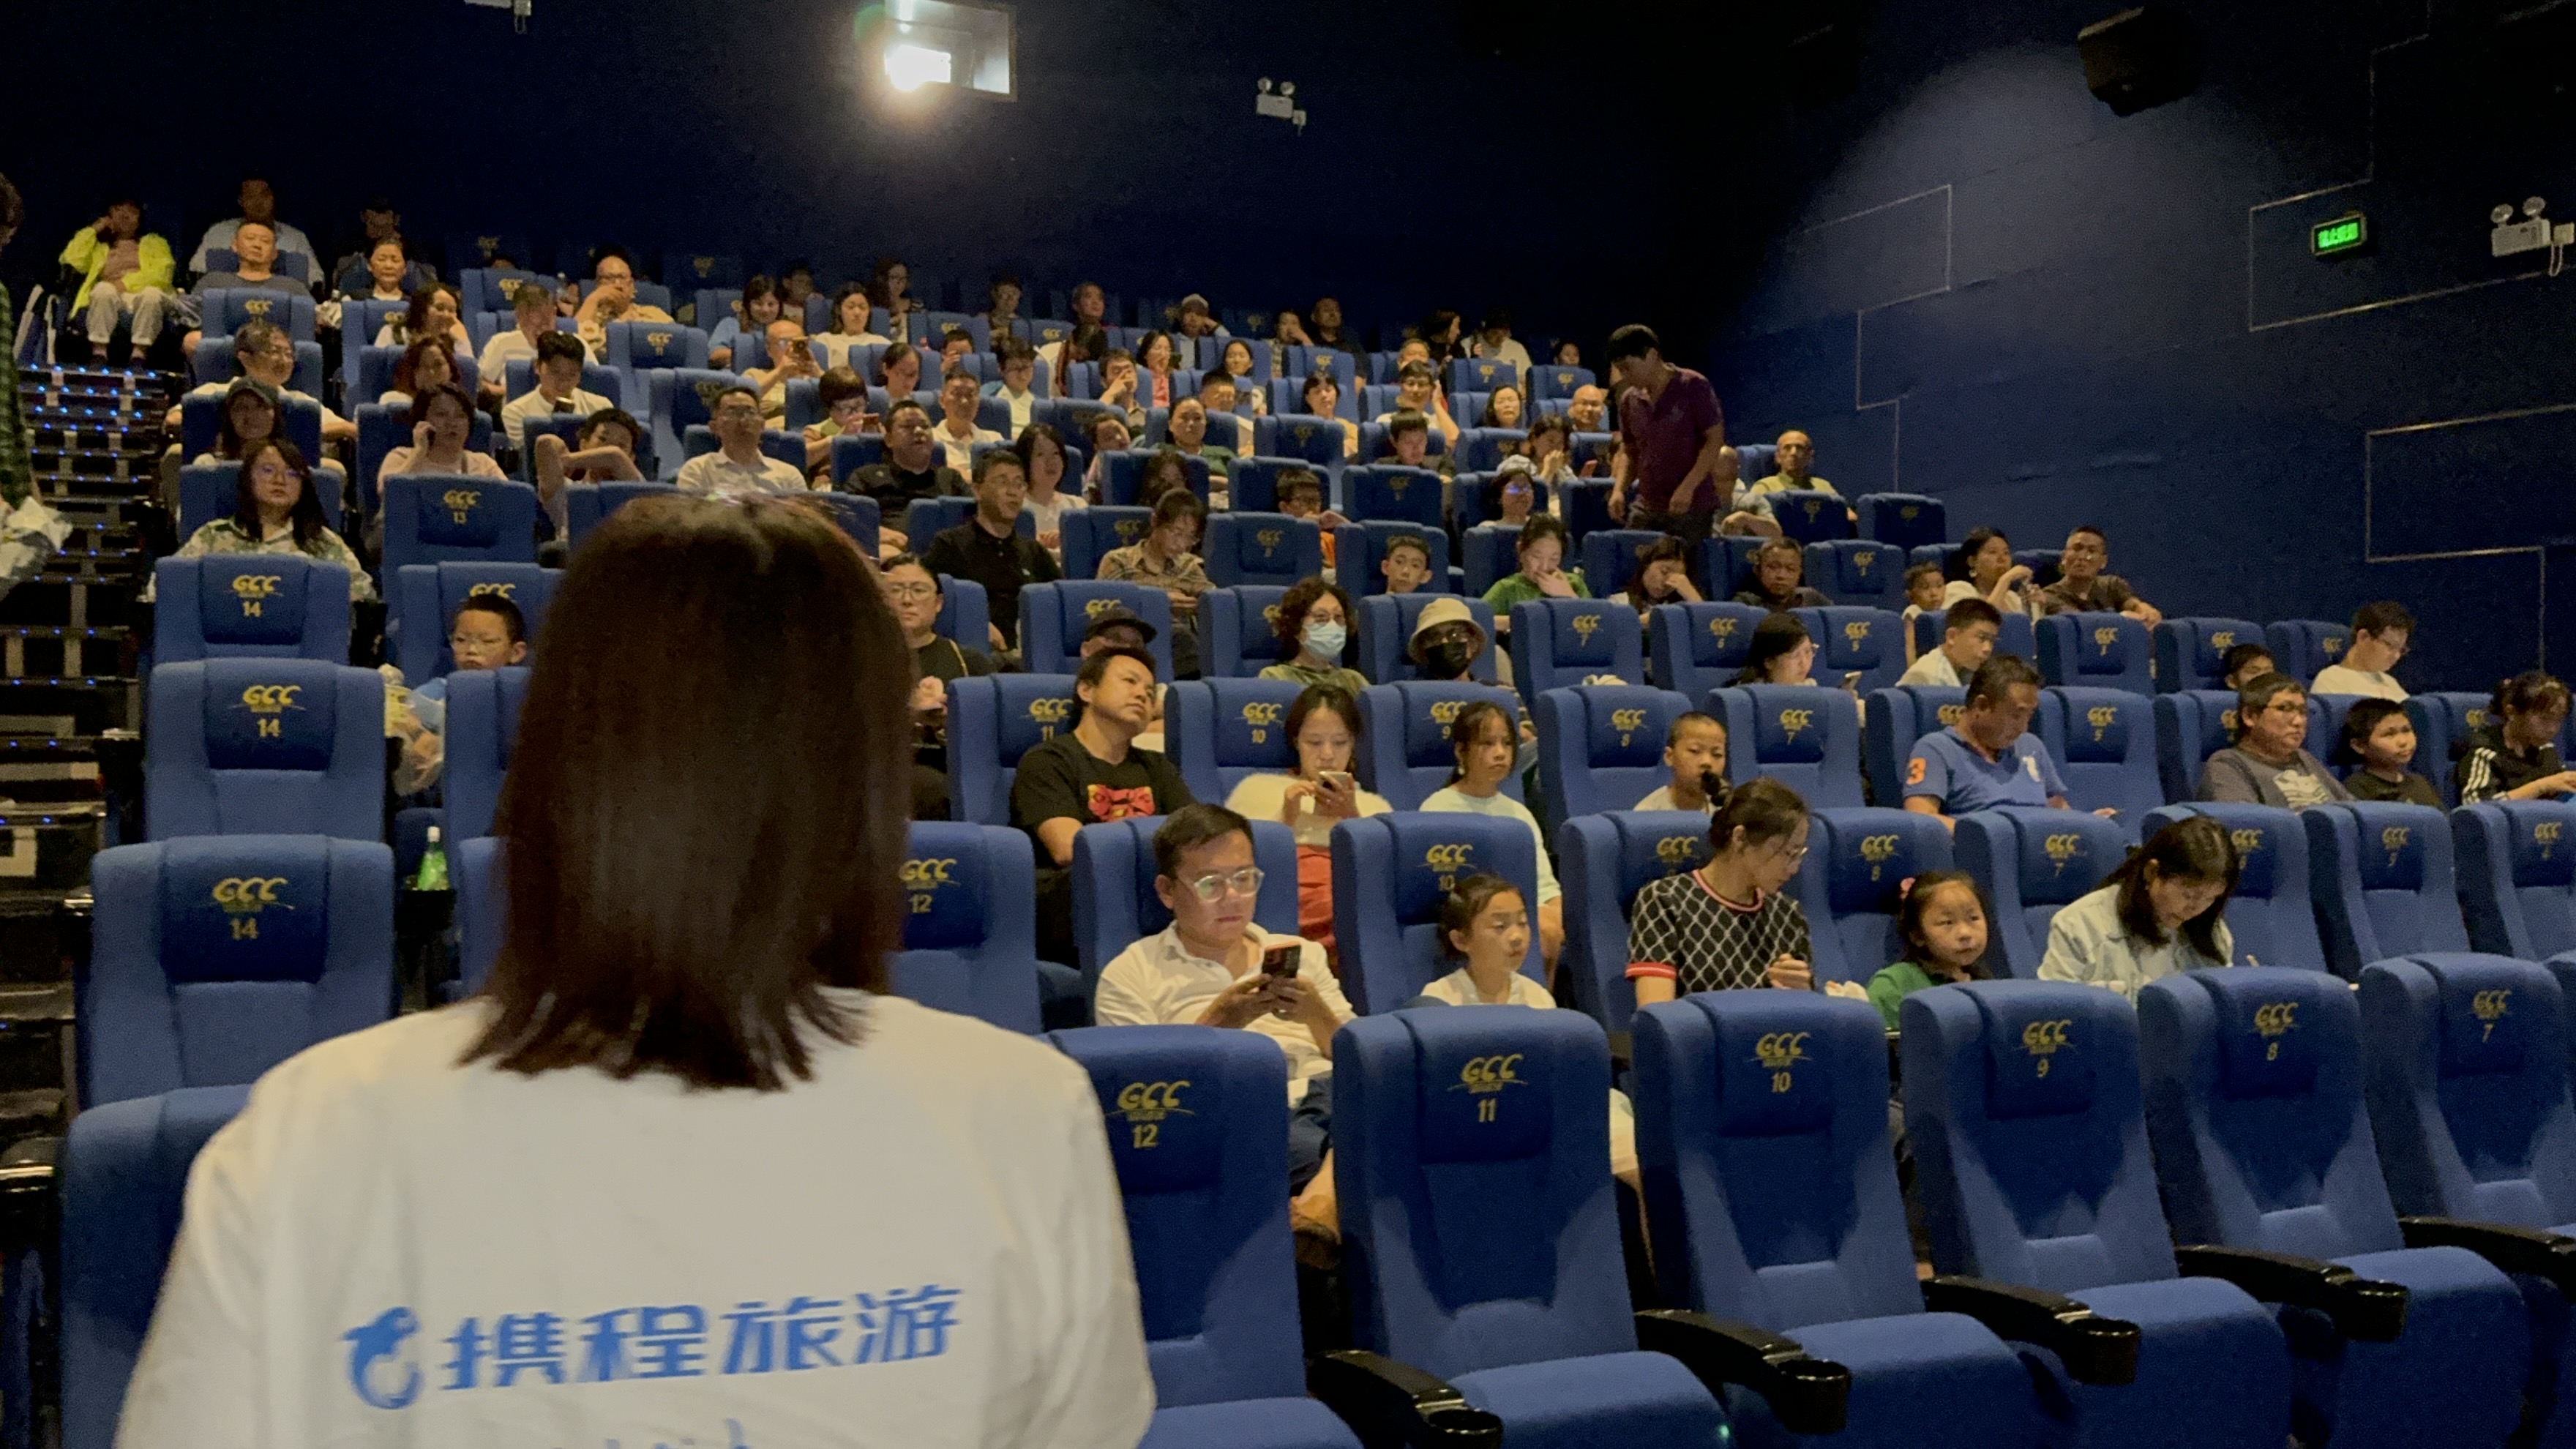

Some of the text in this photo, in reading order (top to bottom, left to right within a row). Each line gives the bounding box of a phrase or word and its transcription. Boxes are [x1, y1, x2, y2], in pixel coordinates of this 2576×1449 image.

[233, 574, 281, 592] GCC
[244, 601, 261, 618] 14
[1572, 615, 1600, 632] GCC
[243, 685, 302, 705] GCC
[1030, 699, 1073, 717] GCC
[1243, 703, 1281, 719] GCC
[1611, 709, 1646, 726] GCC
[1781, 709, 1813, 726] GCC
[2087, 707, 2117, 724] GCC
[256, 719, 280, 738] 14
[1251, 730, 1266, 744] 10
[1906, 757, 1926, 786] 3
[1656, 836, 1699, 856] GCC
[1861, 835, 1900, 854] GCC
[2045, 834, 2080, 853] GCC
[1426, 845, 1473, 864] GCC
[899, 858, 956, 882] GCC
[213, 877, 288, 902] GCC
[910, 894, 932, 914] 12
[231, 918, 258, 942] 14
[2473, 990, 2512, 1014] GCC
[2255, 1002, 2299, 1030] GCC
[2023, 1019, 2072, 1045] GCC
[1756, 1032, 1811, 1058] GCC
[1461, 1054, 1523, 1083] GCC
[2037, 1058, 2049, 1078] 9
[1771, 1071, 1792, 1093] 10
[1118, 1081, 1191, 1111] GCC
[1478, 1098, 1497, 1123] 11
[1132, 1123, 1159, 1149] 12
[439, 1284, 962, 1390] 携程旅游
